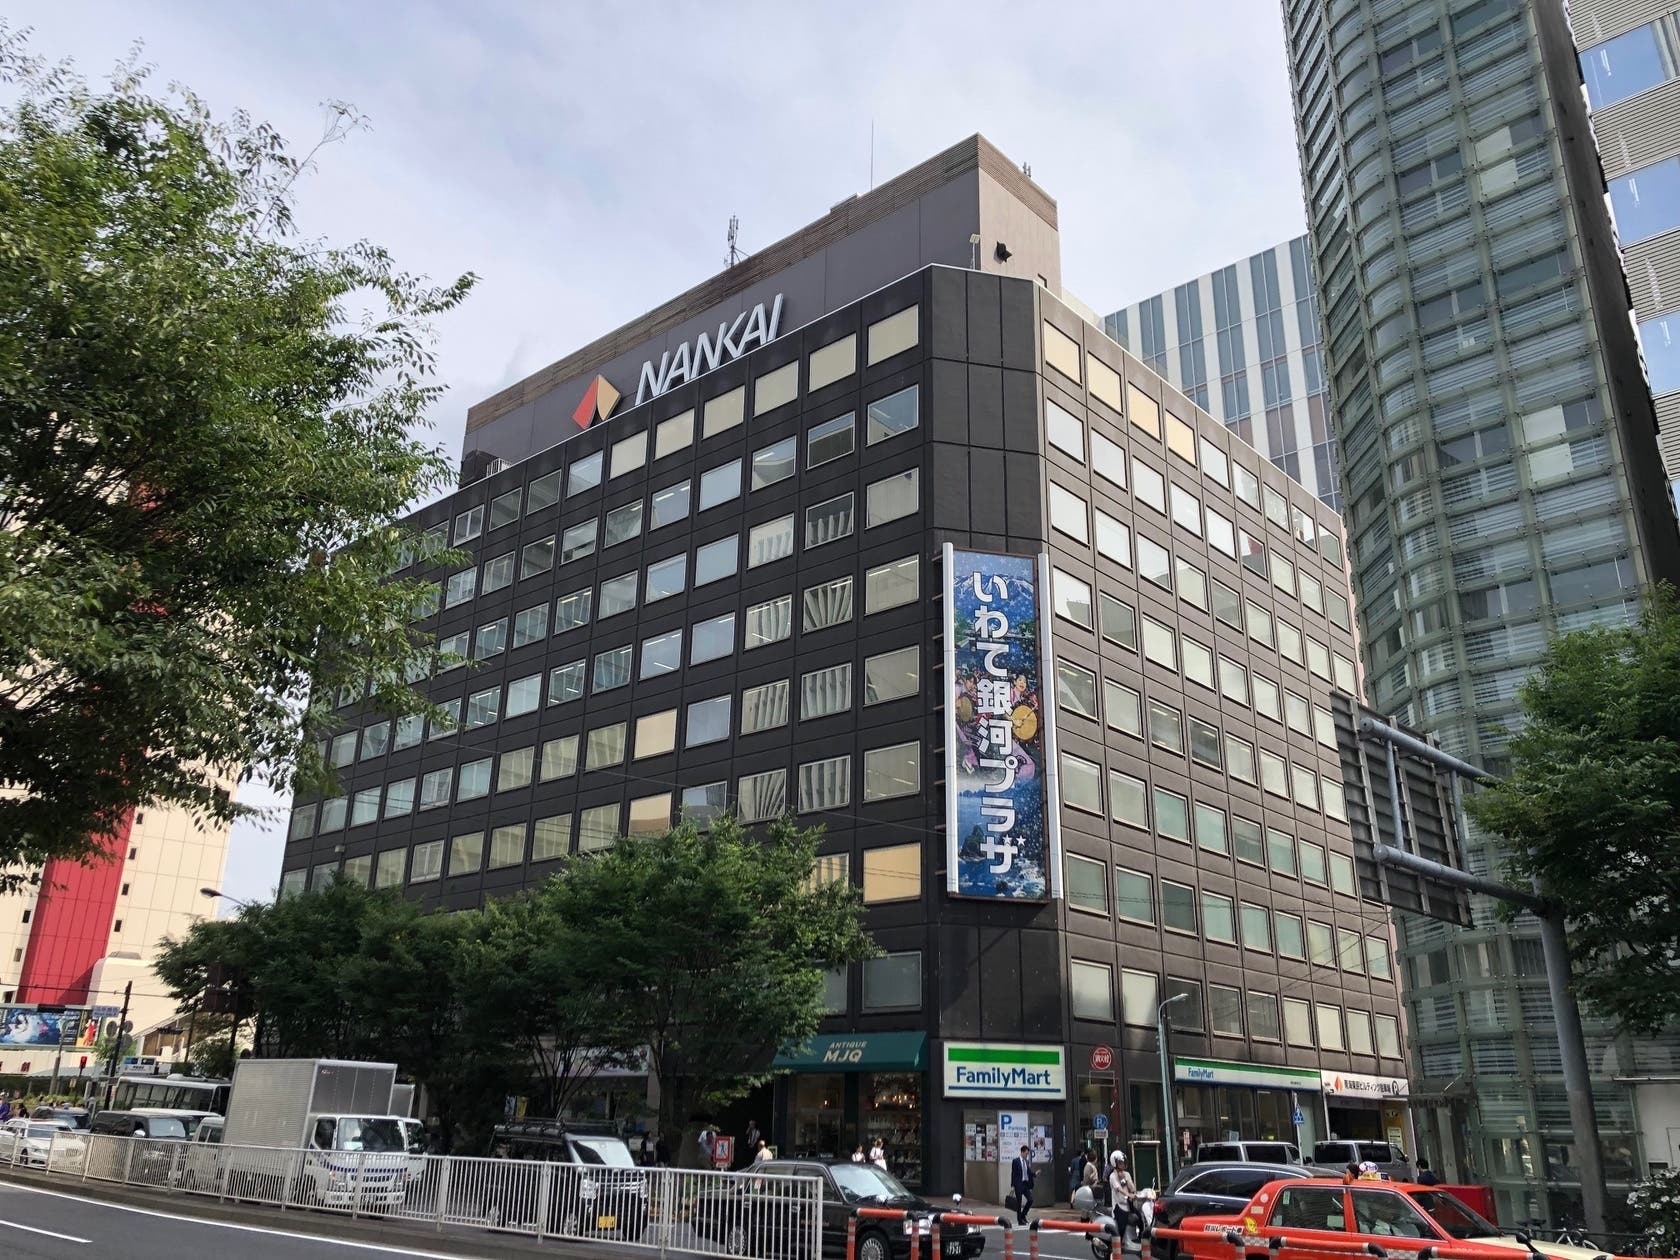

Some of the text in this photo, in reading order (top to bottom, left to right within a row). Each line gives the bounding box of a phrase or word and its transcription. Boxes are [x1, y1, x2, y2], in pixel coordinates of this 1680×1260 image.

[634, 293, 783, 406] NANKAI
[972, 571, 1027, 874] いわて銀河プラザ
[829, 1041, 868, 1049] ANTIQUE
[823, 1049, 863, 1063] MJQ
[956, 1066, 1051, 1087] FamilyMart
[1188, 1067, 1214, 1080] FamilyMart
[1001, 1114, 1012, 1130] P
